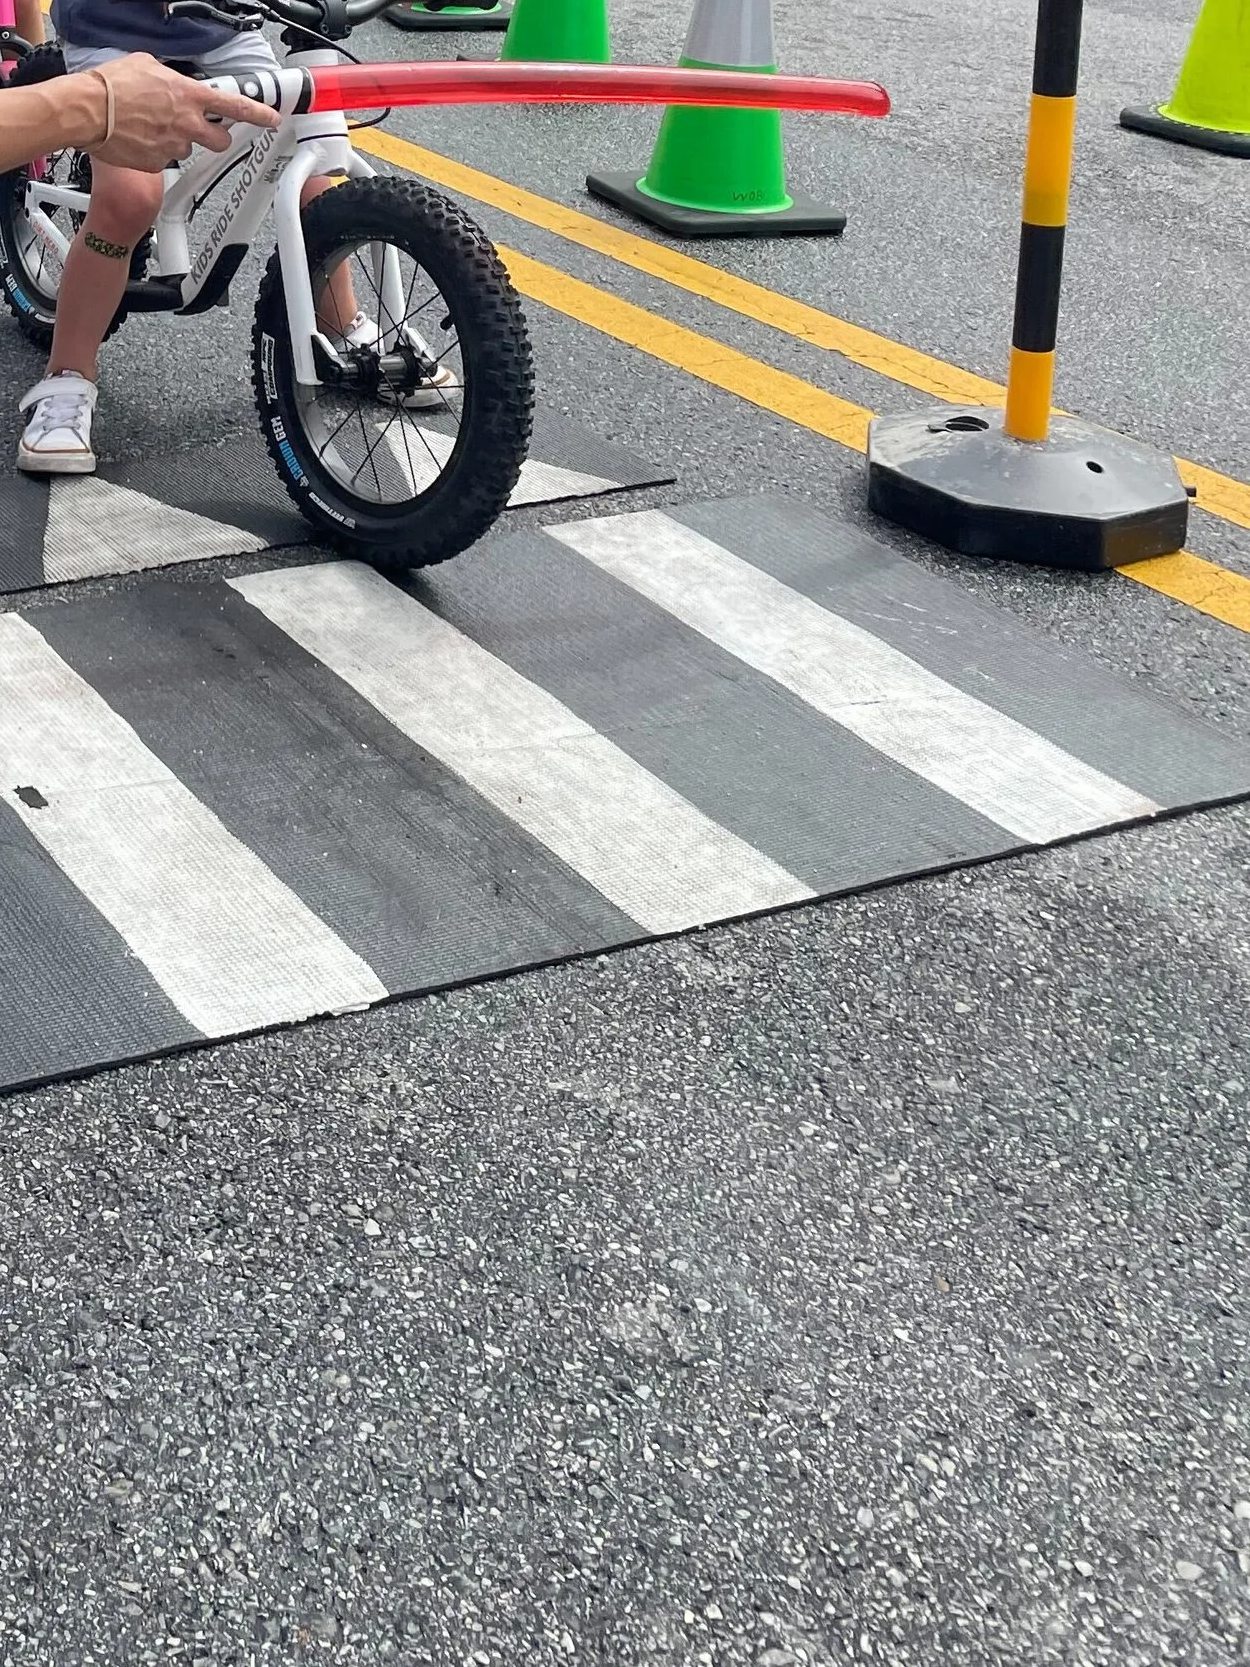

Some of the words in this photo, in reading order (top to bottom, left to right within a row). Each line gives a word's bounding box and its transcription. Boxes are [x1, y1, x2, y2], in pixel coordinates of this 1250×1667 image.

[190, 243, 214, 285] KIDS
[210, 209, 234, 249] RIDE
[230, 127, 279, 210] SHOTGUN
[270, 415, 287, 441] GEM
